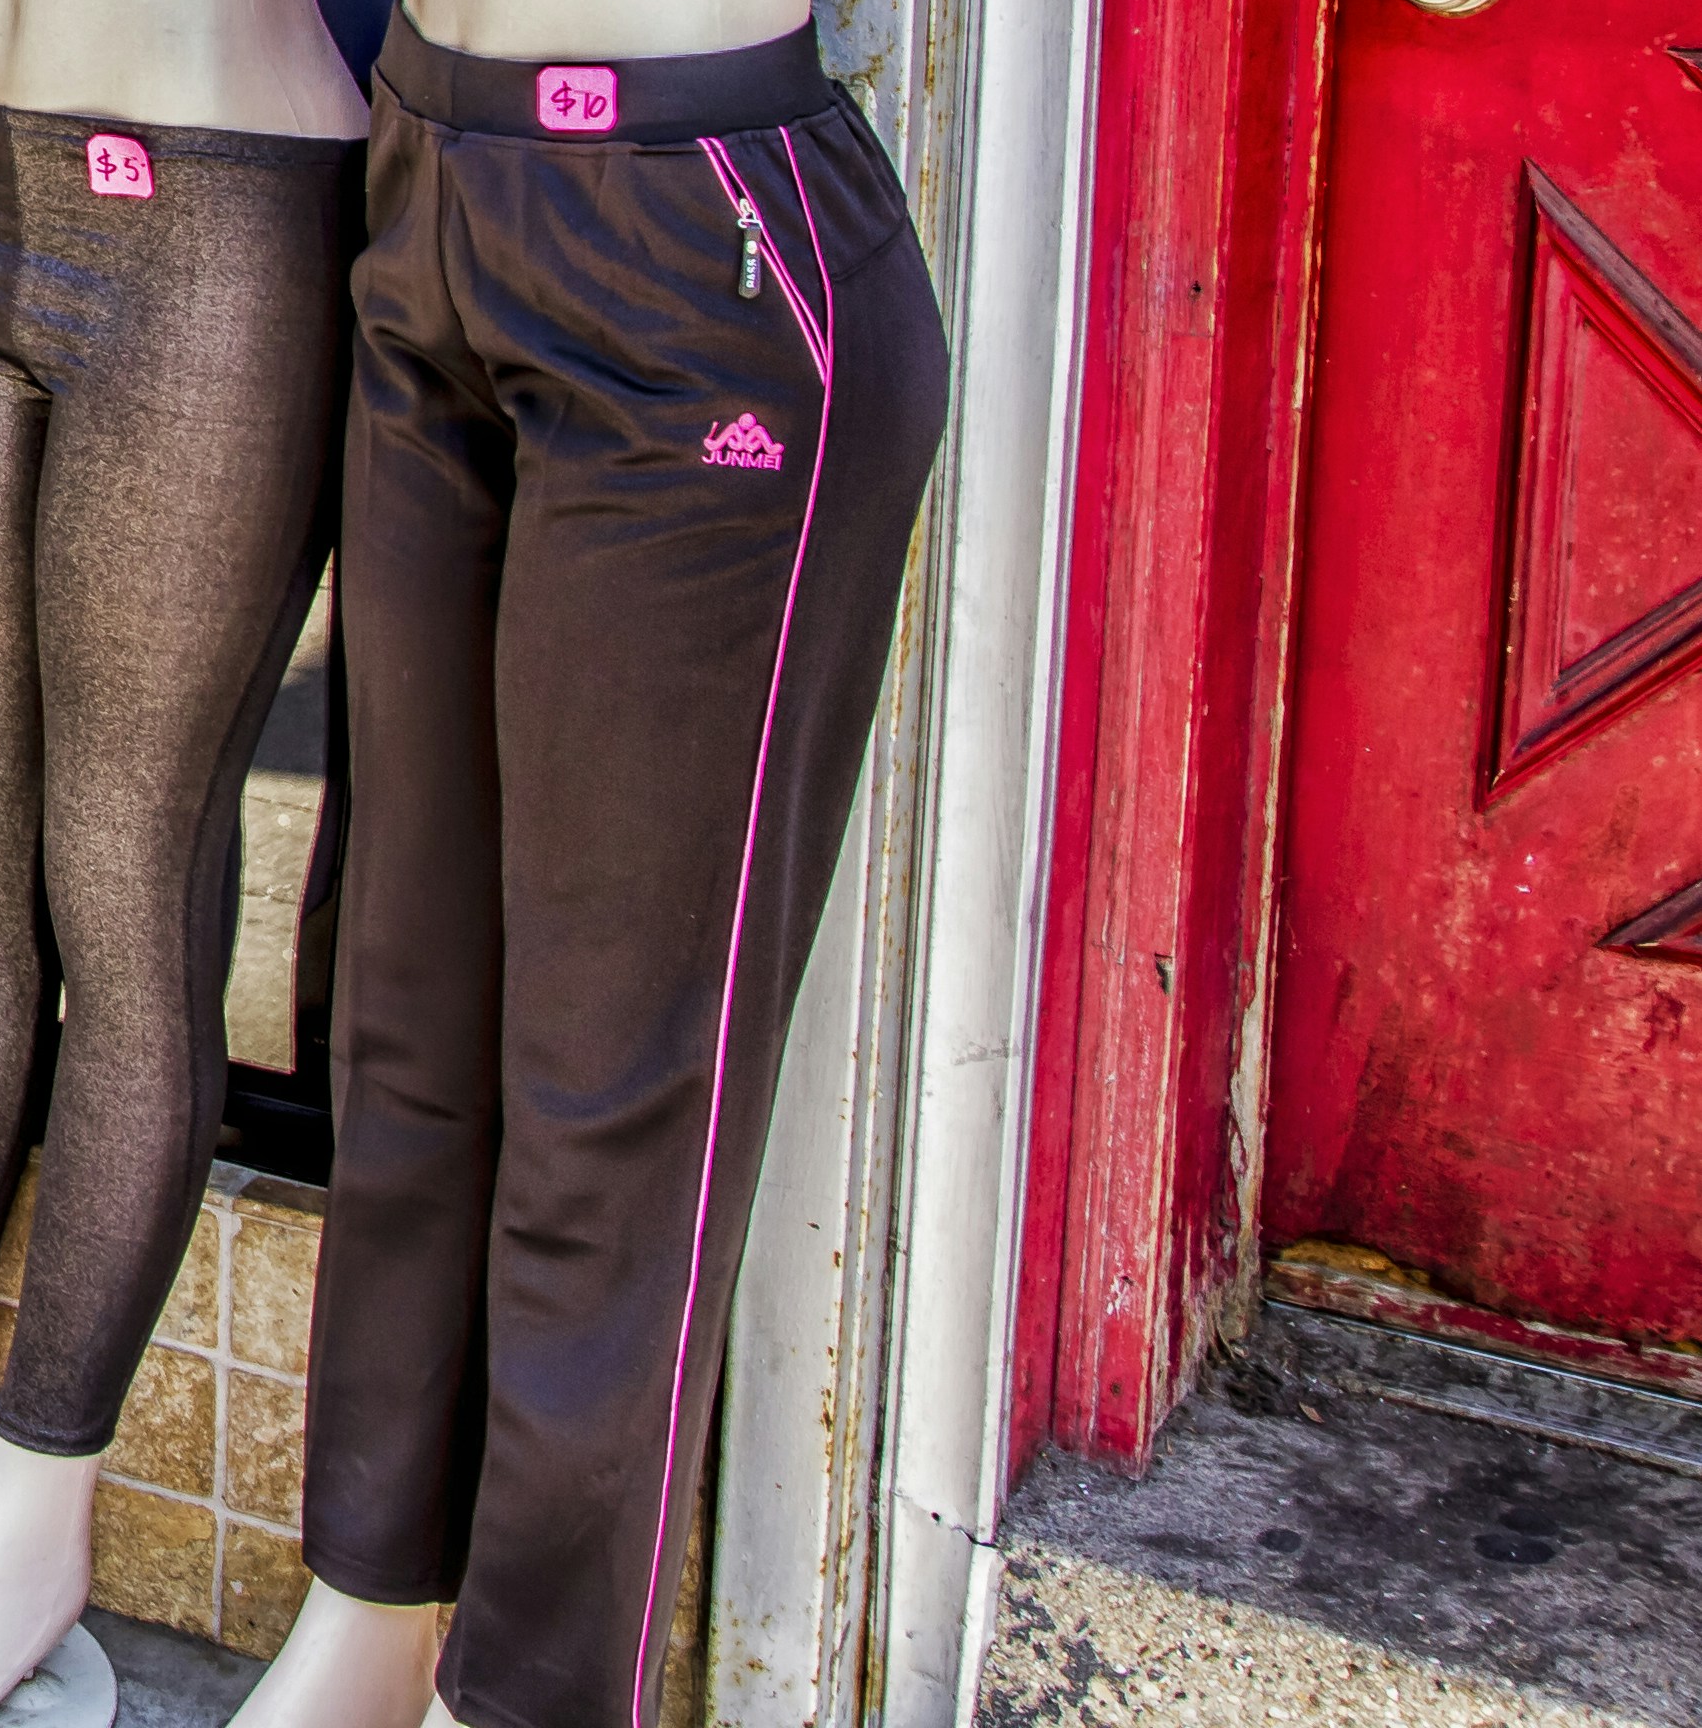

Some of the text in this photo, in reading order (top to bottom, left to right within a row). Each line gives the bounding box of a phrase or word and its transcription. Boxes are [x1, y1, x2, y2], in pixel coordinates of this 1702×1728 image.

[550, 80, 608, 120] $10
[96, 147, 140, 182] $5
[701, 450, 783, 472] JUNMEI
